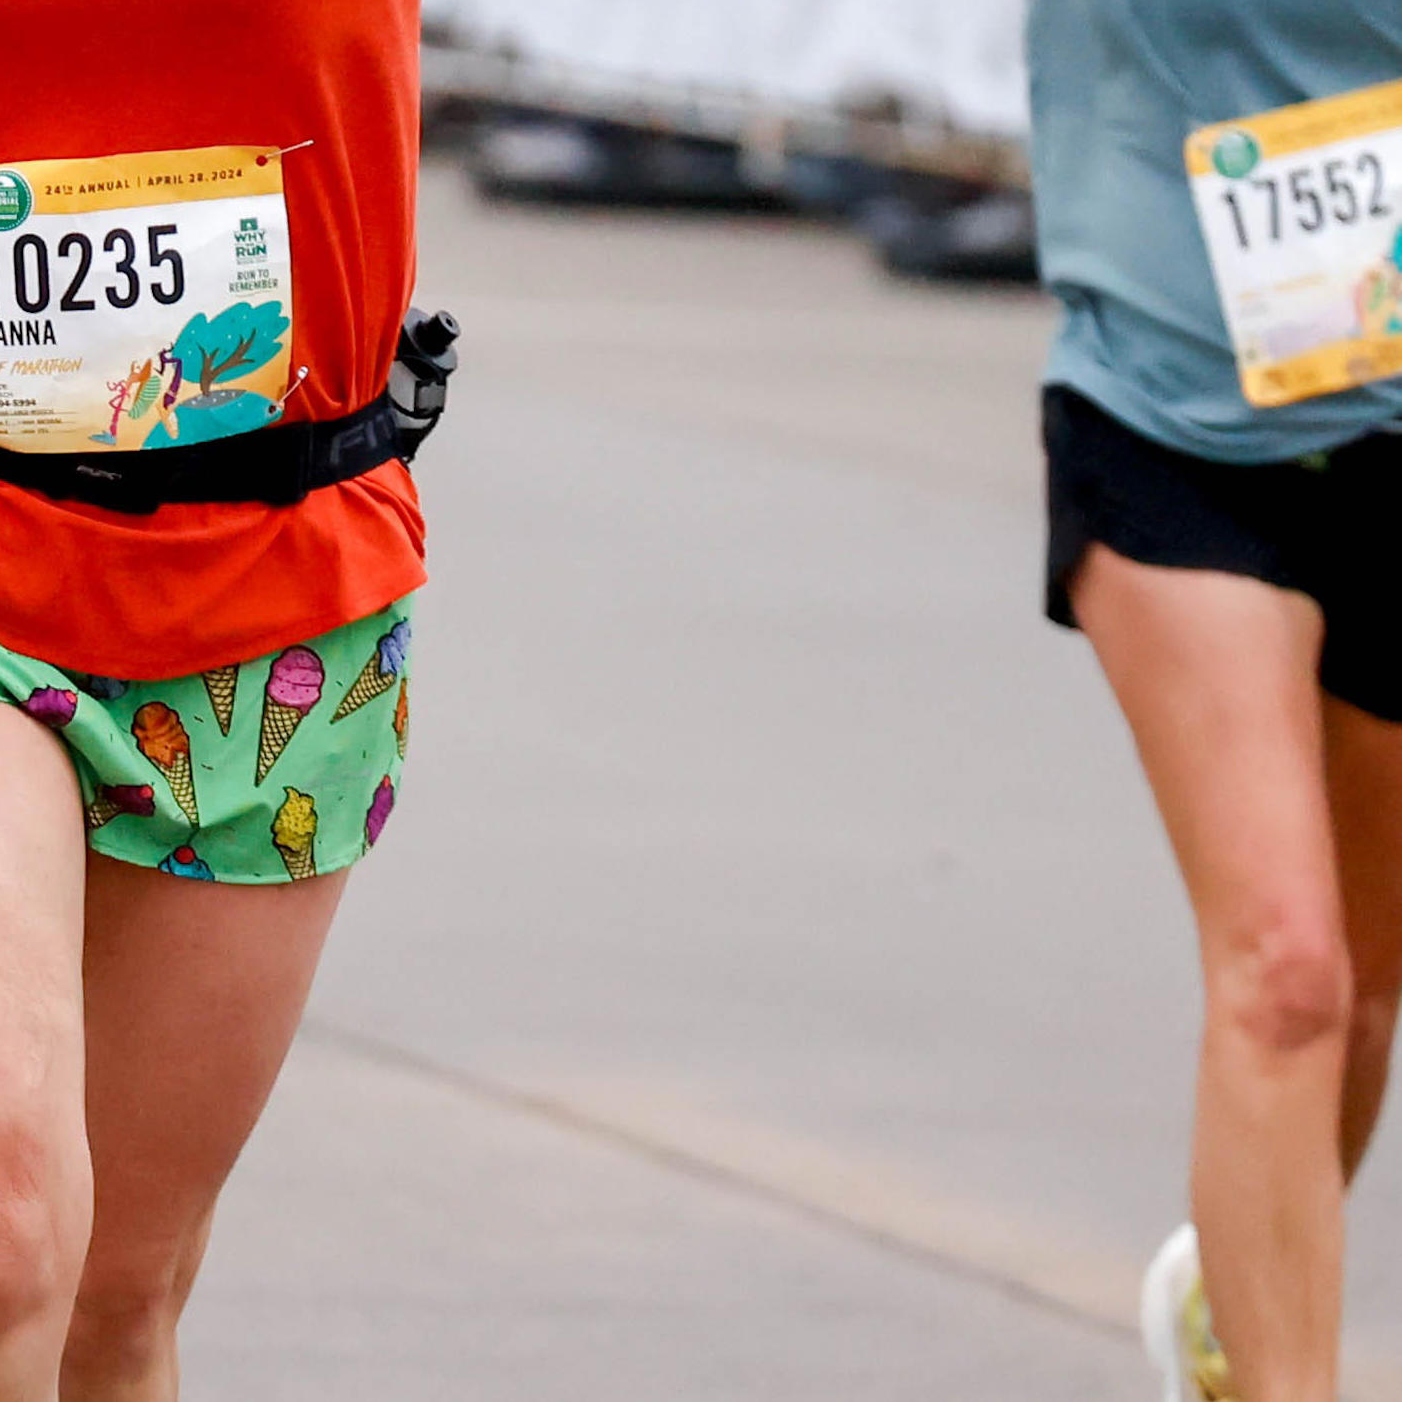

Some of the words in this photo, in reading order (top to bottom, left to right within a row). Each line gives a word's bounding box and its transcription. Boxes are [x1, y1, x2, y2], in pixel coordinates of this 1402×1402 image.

[79, 178, 131, 195] ANNUAL
[147, 175, 185, 187] APRIL
[1219, 152, 1392, 251] 17552
[233, 229, 267, 243] WHY
[257, 268, 270, 279] TO
[229, 278, 279, 294] REMEMBER
[10, 356, 84, 377] MARATHON
